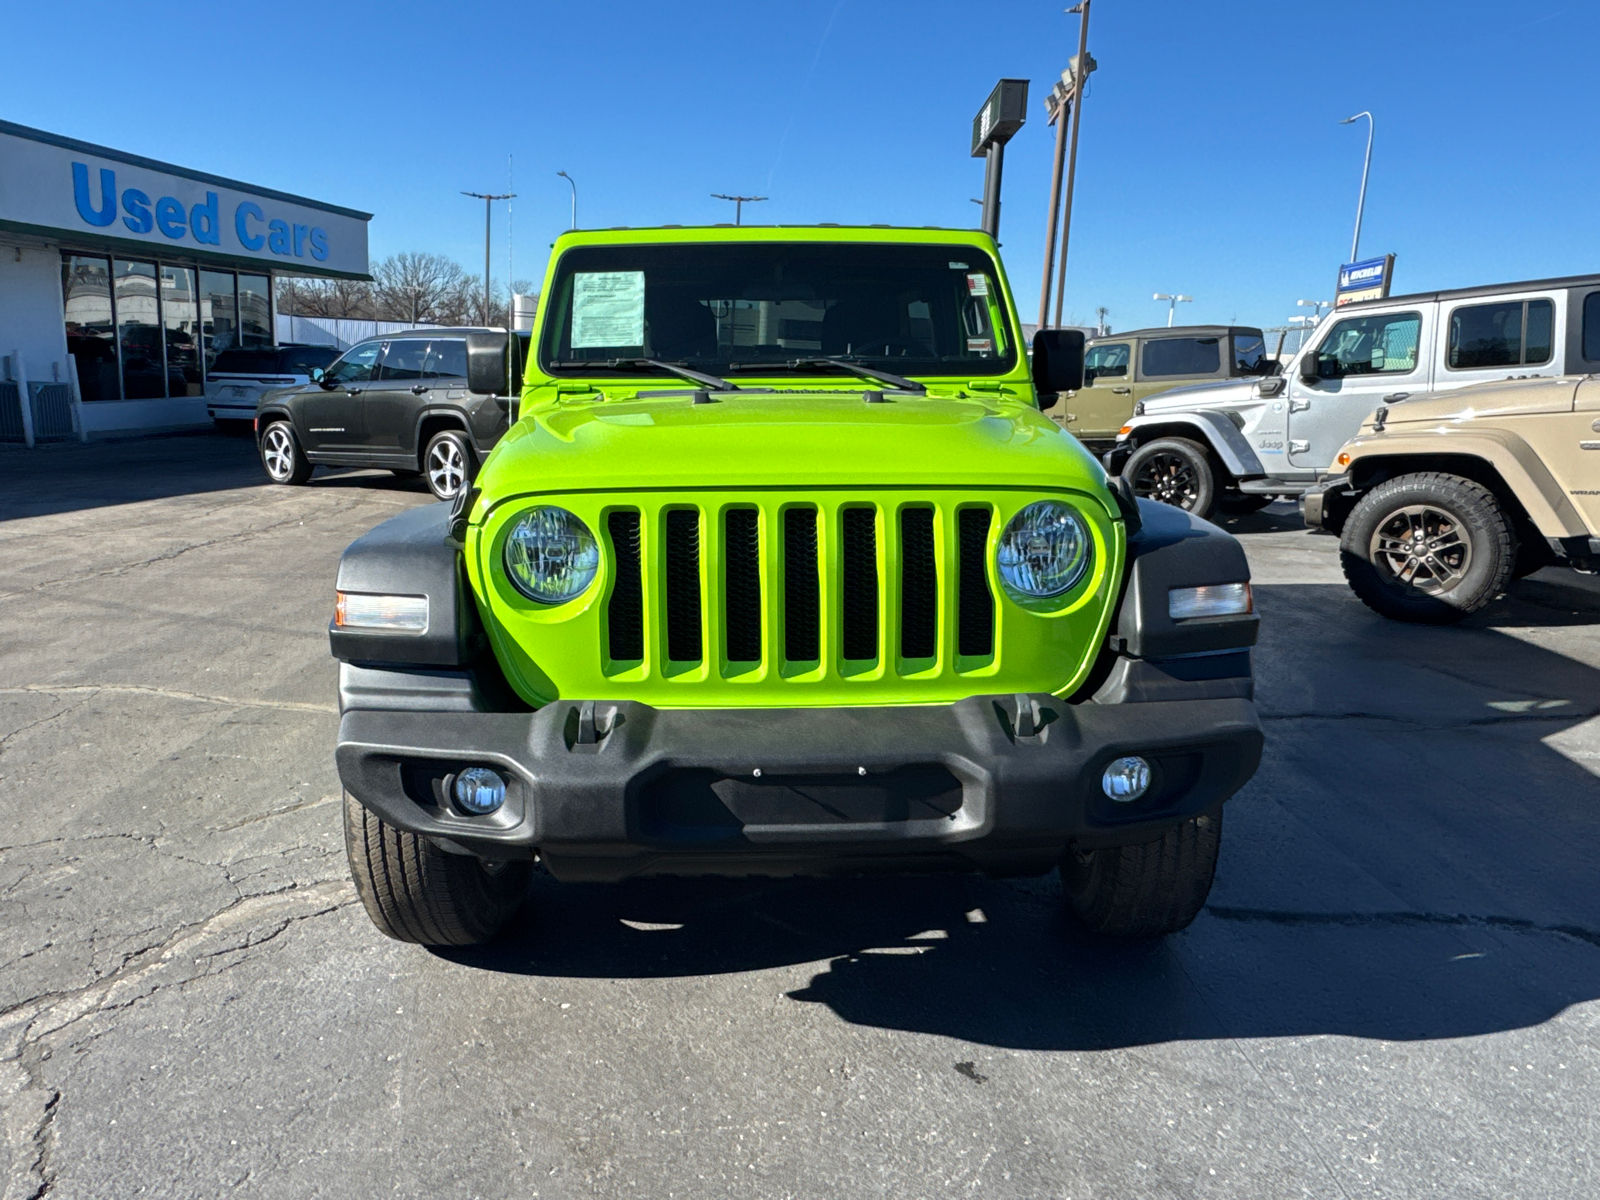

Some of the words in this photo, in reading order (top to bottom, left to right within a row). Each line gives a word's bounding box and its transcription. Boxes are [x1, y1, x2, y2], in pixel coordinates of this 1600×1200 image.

[71, 161, 220, 246] Used
[235, 201, 329, 262] Cars
[1259, 440, 1283, 450] Jeep
